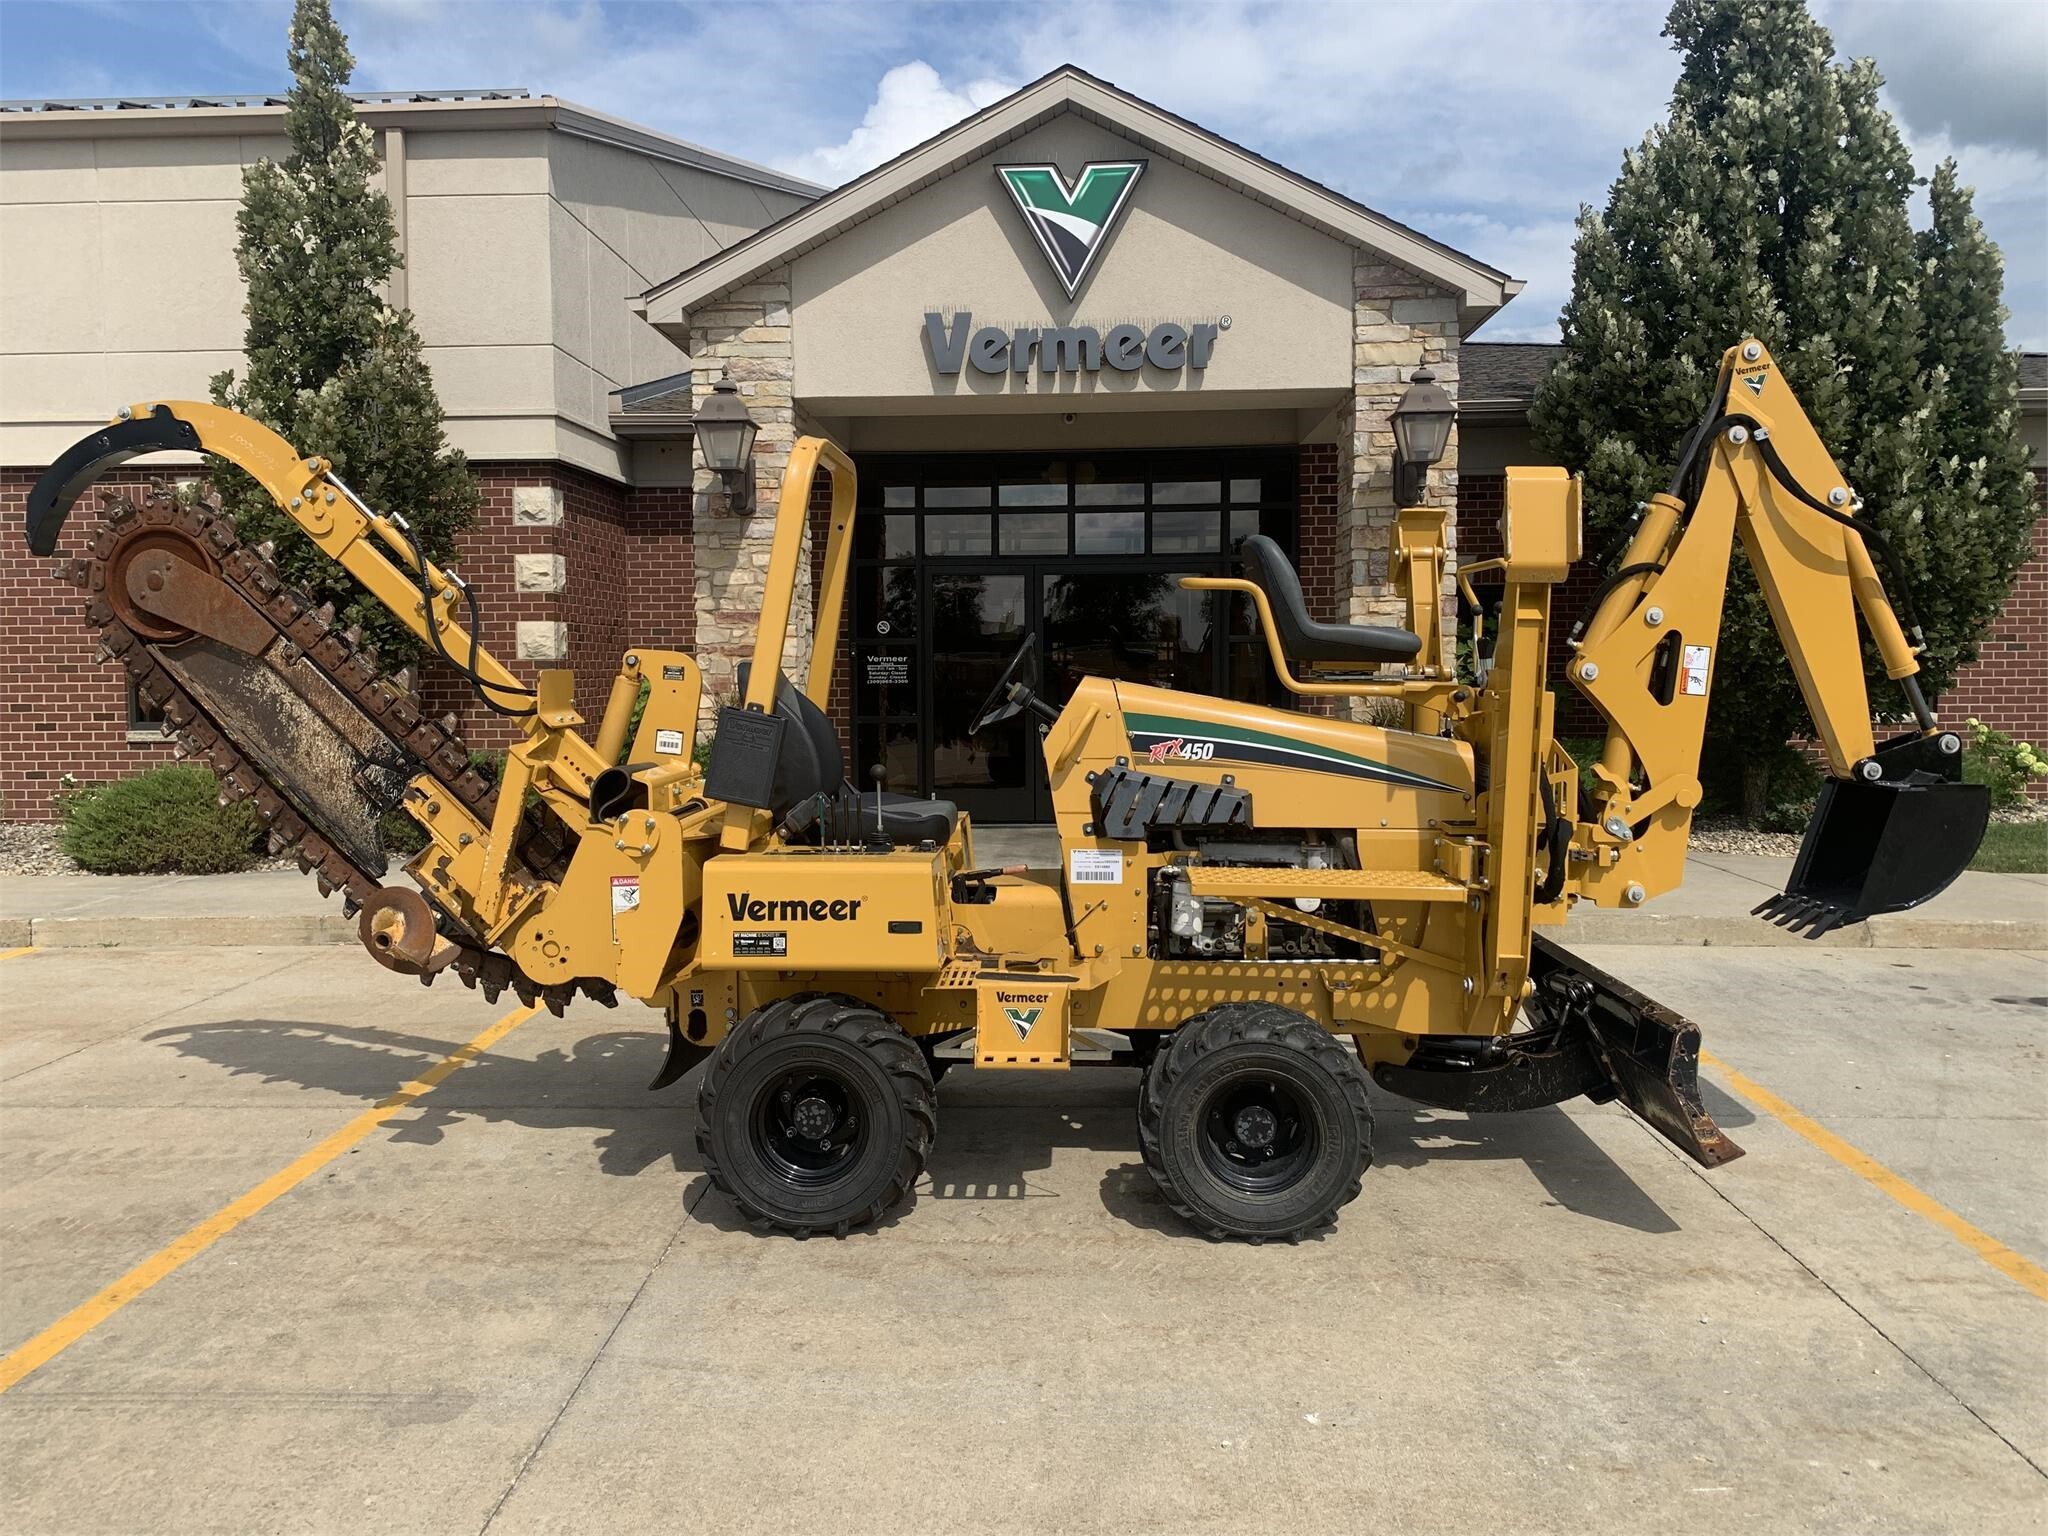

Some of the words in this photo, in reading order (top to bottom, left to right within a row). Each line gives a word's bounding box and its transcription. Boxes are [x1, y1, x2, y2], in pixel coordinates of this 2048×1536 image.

[1735, 363, 1770, 375] Vermeer
[727, 893, 861, 921] Vermeer
[996, 992, 1048, 1002] Vermeer
